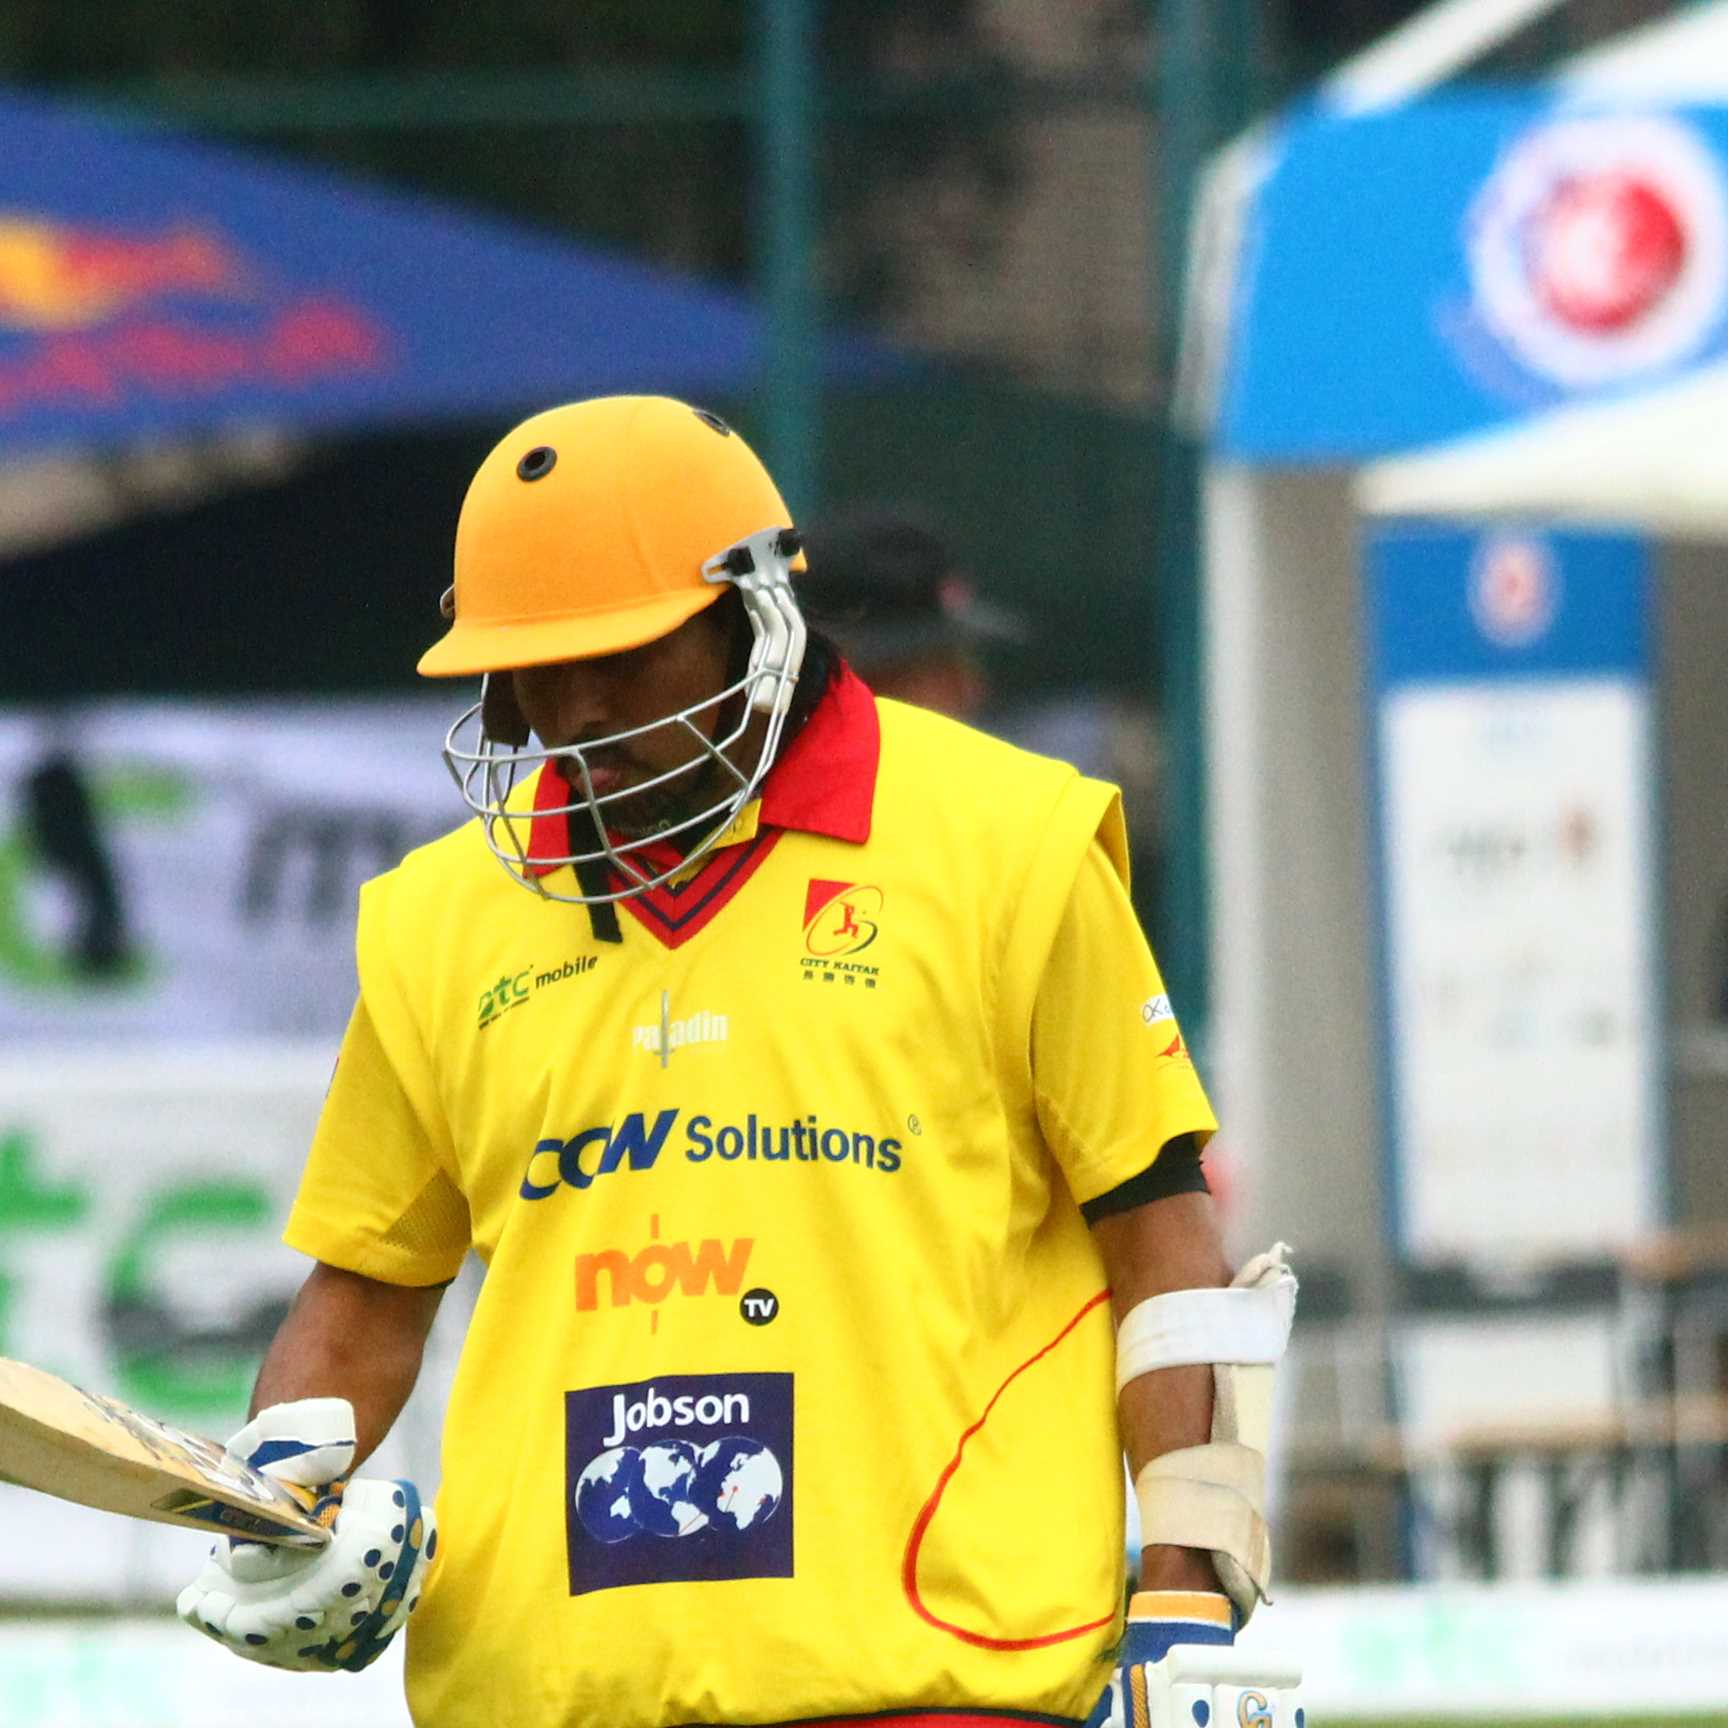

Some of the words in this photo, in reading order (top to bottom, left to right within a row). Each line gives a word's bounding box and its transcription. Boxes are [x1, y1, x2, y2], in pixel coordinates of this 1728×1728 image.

[535, 954, 598, 990] mobile
[685, 1113, 903, 1174] Solutions
[575, 1238, 754, 1312] now
[744, 1299, 775, 1317] TV
[602, 1387, 750, 1447] Jobson
